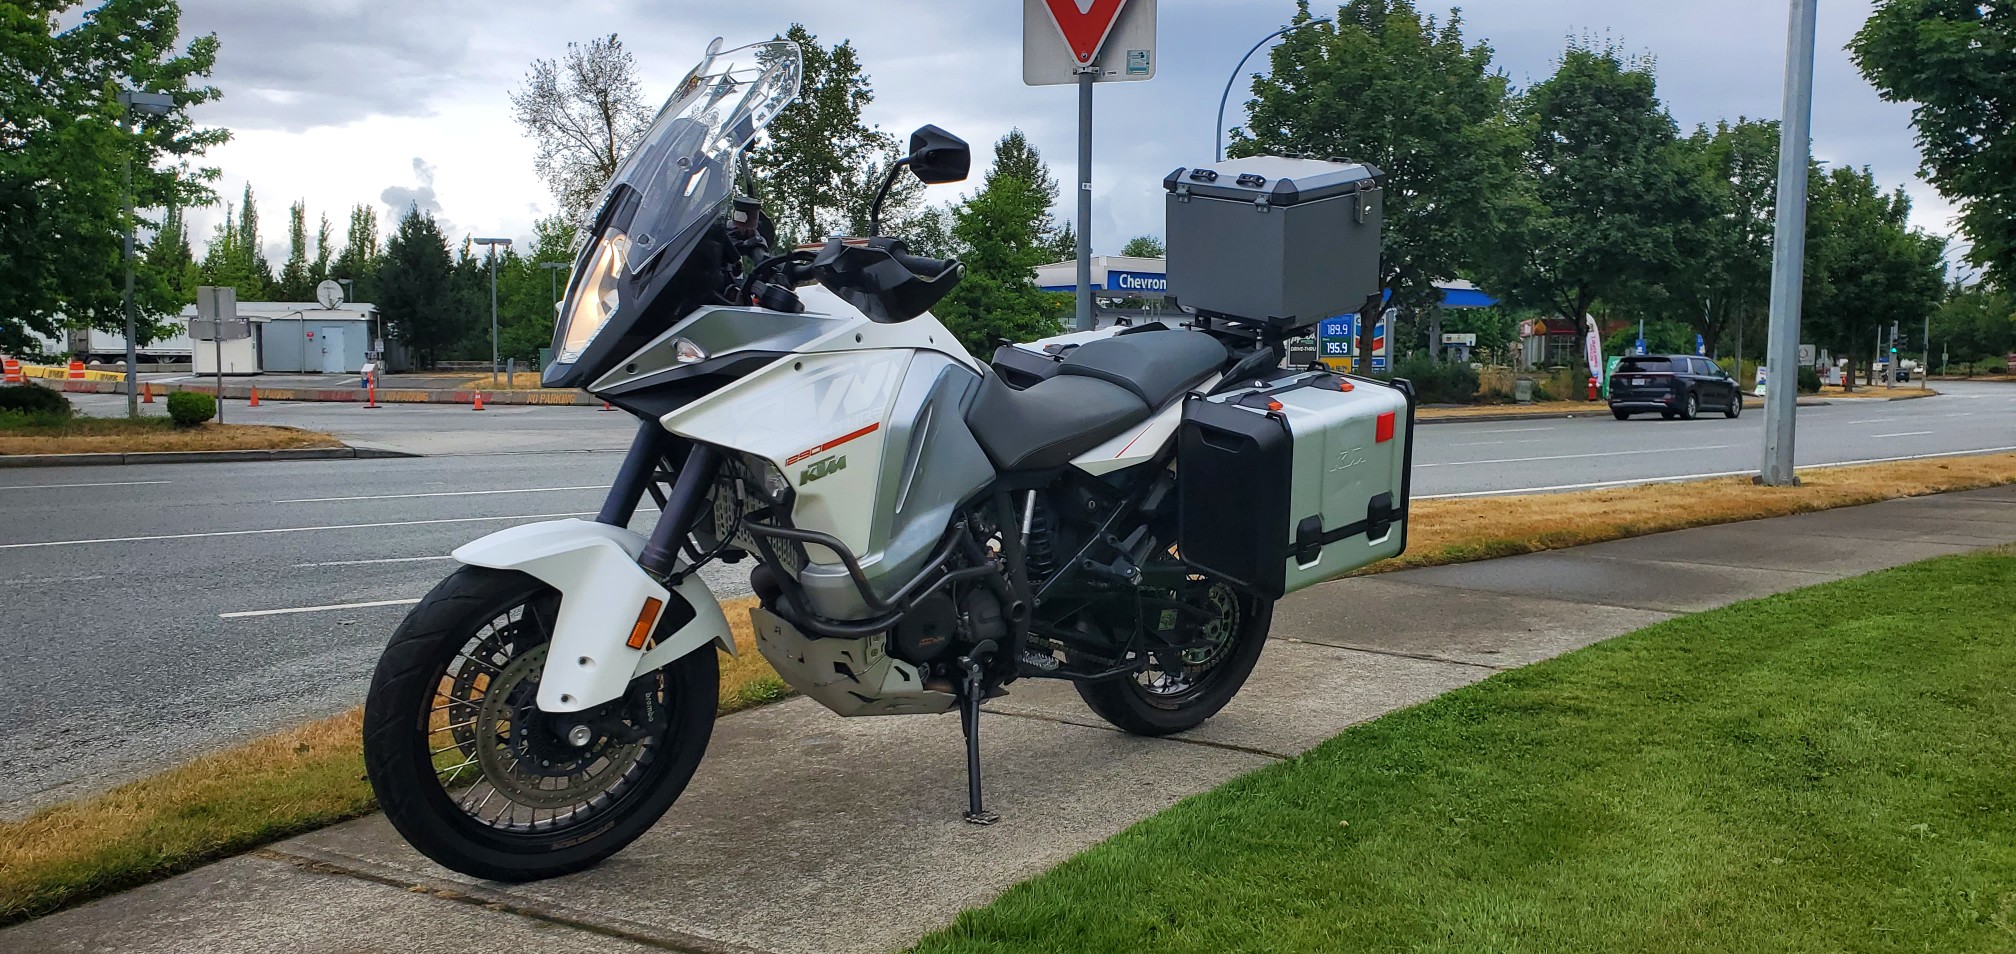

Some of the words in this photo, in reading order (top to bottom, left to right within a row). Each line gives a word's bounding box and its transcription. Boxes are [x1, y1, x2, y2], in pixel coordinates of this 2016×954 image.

[1119, 273, 1166, 290] Chevron
[1327, 324, 1348, 335] 189.9
[1326, 342, 1348, 354] 195.9
[527, 393, 539, 404] NO
[540, 393, 577, 404] PARKING
[785, 445, 822, 467] 1290
[799, 455, 847, 486] KTM
[645, 692, 654, 722] brembo
